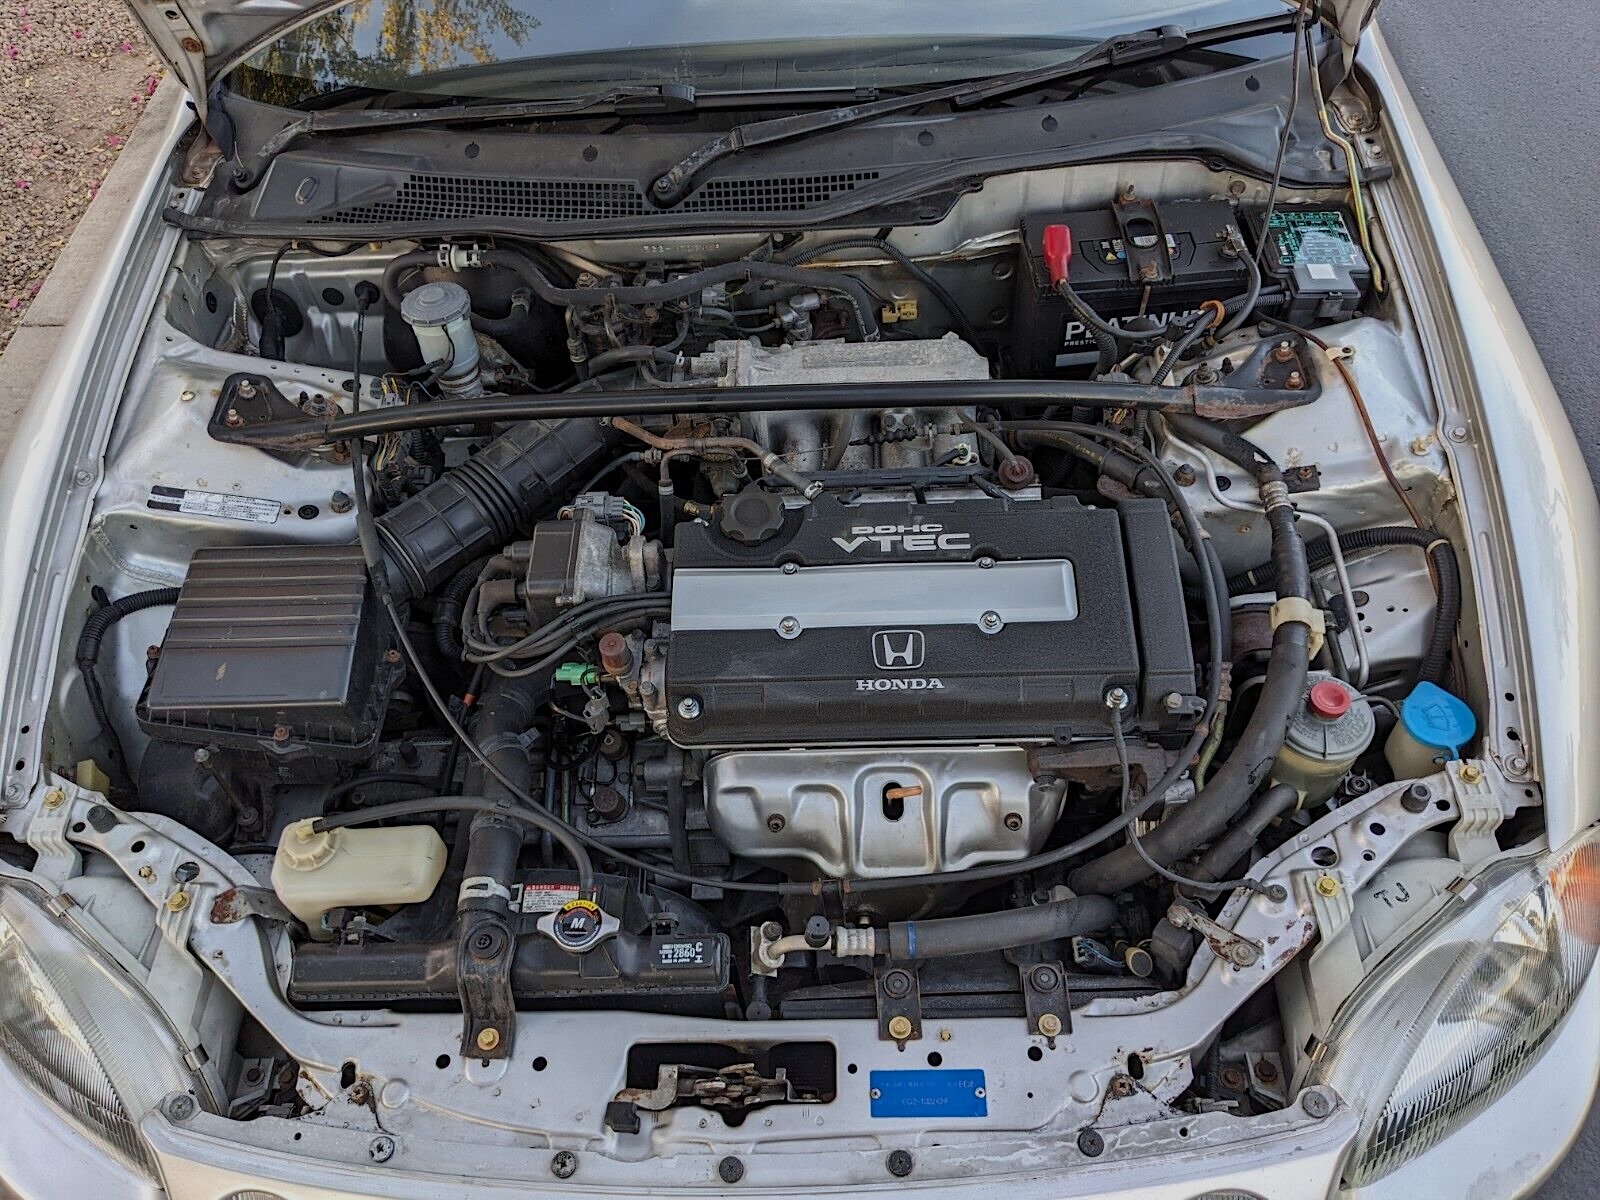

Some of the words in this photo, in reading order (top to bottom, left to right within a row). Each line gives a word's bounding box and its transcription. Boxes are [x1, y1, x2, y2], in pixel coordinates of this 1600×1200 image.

[852, 523, 943, 534] DOHC
[831, 533, 971, 553] VTEC
[855, 678, 945, 691] HONDA
[673, 948, 696, 958] 2860
